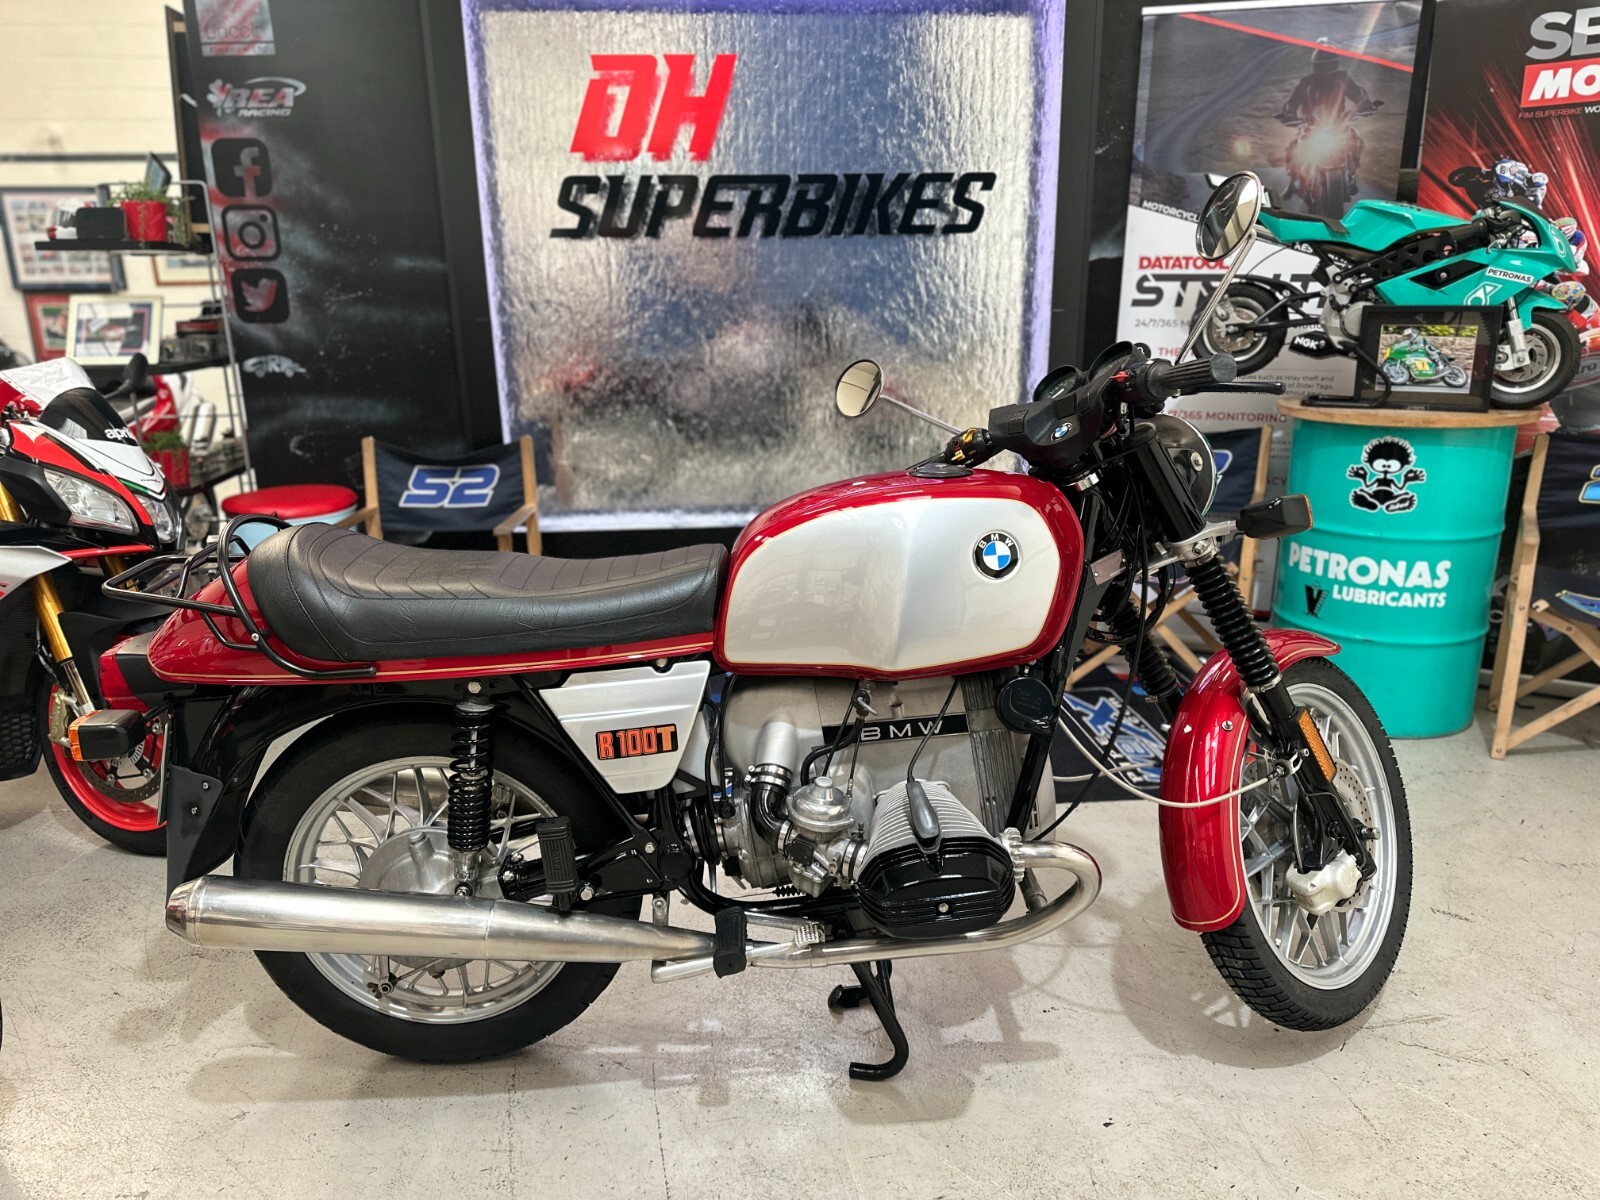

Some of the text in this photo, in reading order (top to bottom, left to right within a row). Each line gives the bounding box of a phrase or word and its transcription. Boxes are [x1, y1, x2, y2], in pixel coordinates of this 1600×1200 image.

[238, 108, 292, 117] RACING
[570, 54, 738, 162] DH
[1535, 107, 1583, 118] SUPERBIKE
[550, 172, 997, 239] SUPERBIKES
[1142, 200, 1200, 222] MOTORCYCL
[1138, 256, 1230, 270] DATATOOL
[1487, 268, 1532, 282] PETRONAS
[1295, 336, 1319, 349] NGK
[1206, 411, 1287, 423] MONITORING
[399, 464, 501, 508] 52
[978, 532, 1016, 549] BMW
[1289, 541, 1452, 589] PETRONAS
[1332, 584, 1448, 608] LUBRICANTS
[861, 719, 943, 742] BMW
